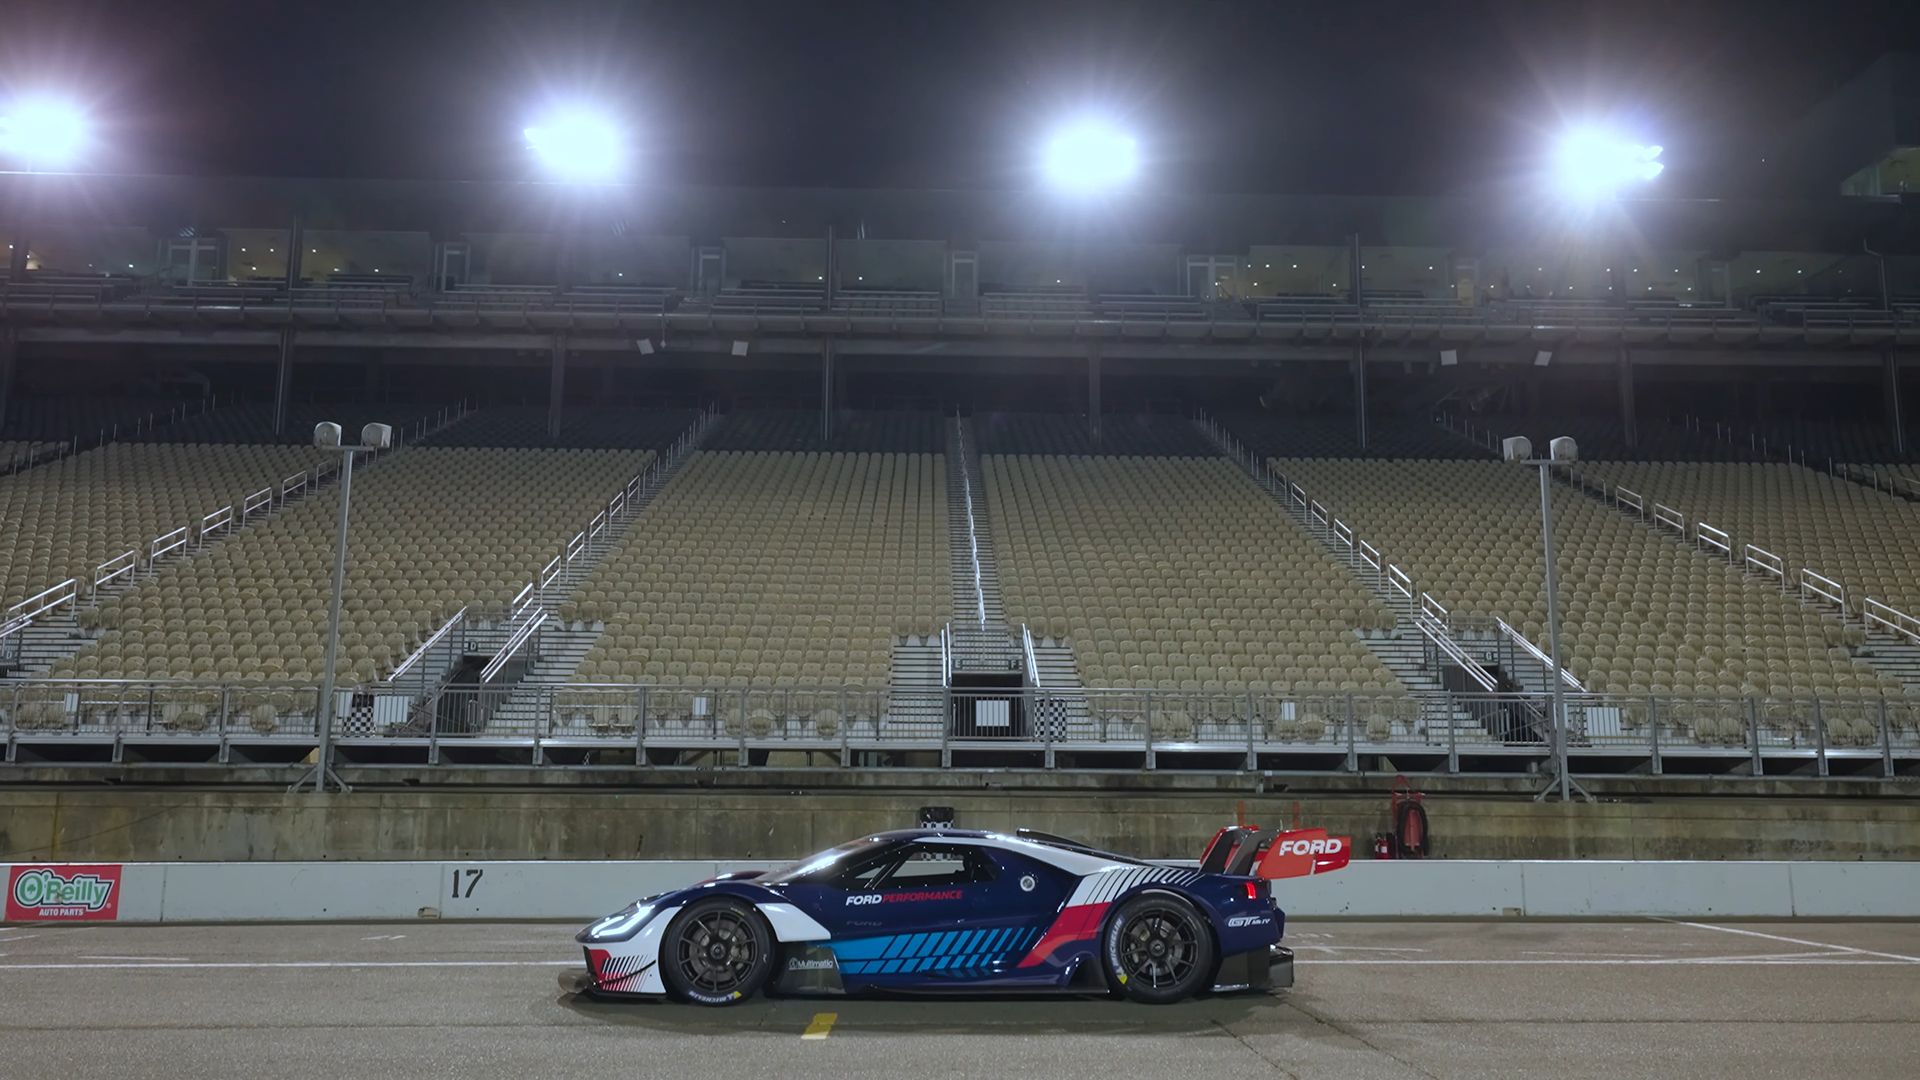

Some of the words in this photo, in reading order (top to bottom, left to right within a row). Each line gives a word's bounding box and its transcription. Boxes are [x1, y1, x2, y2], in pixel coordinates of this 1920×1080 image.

[1279, 839, 1342, 856] FORD
[17, 871, 110, 907] O'Reilly
[452, 869, 483, 898] 17
[845, 894, 882, 906] FORD
[882, 889, 963, 904] PERFORMANCE
[39, 908, 59, 917] AUTO
[59, 908, 84, 916] PARTS
[1228, 916, 1260, 927] GT
[1109, 917, 1122, 967] MICHELIN
[798, 959, 834, 969] Multimatic
